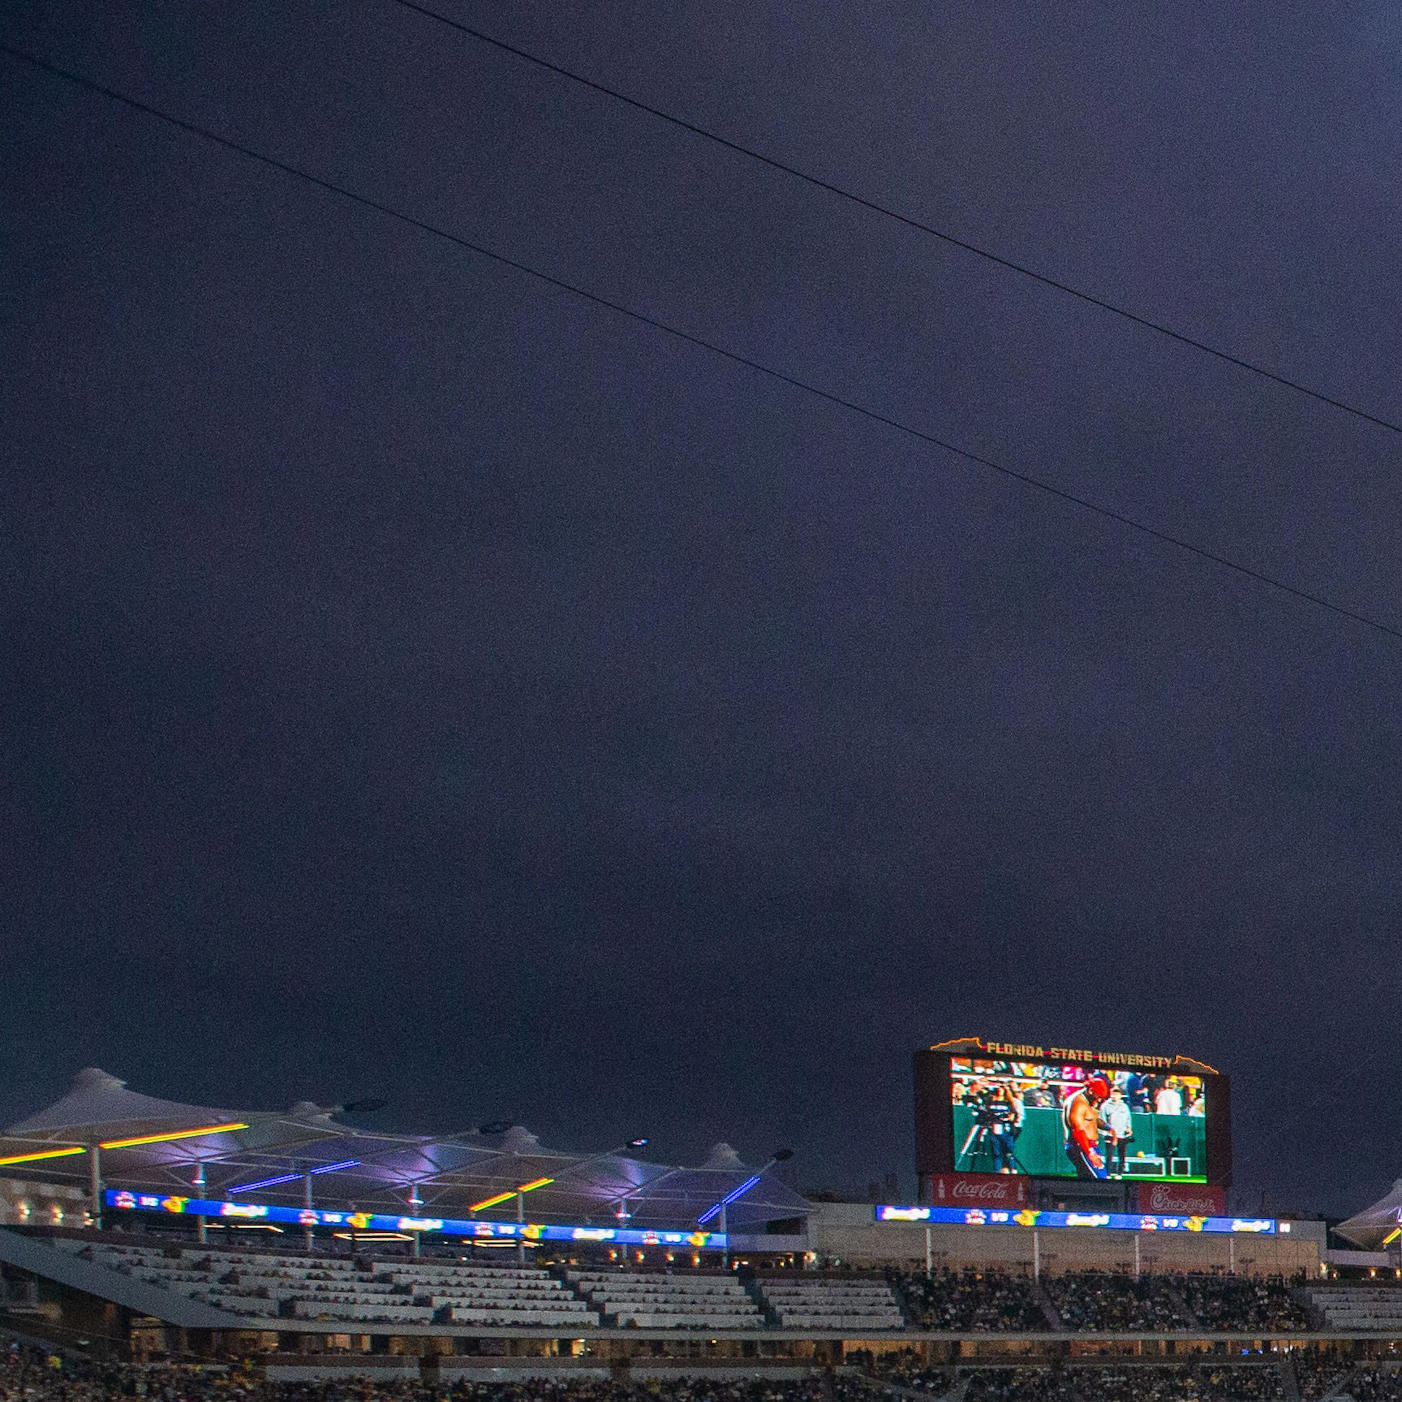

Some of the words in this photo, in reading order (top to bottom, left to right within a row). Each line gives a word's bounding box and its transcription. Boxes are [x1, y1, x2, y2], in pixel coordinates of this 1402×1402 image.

[987, 1042, 1044, 1057] FLORIDA
[1051, 1047, 1093, 1062] STATE
[1099, 1052, 1173, 1067] UNIVERSITY
